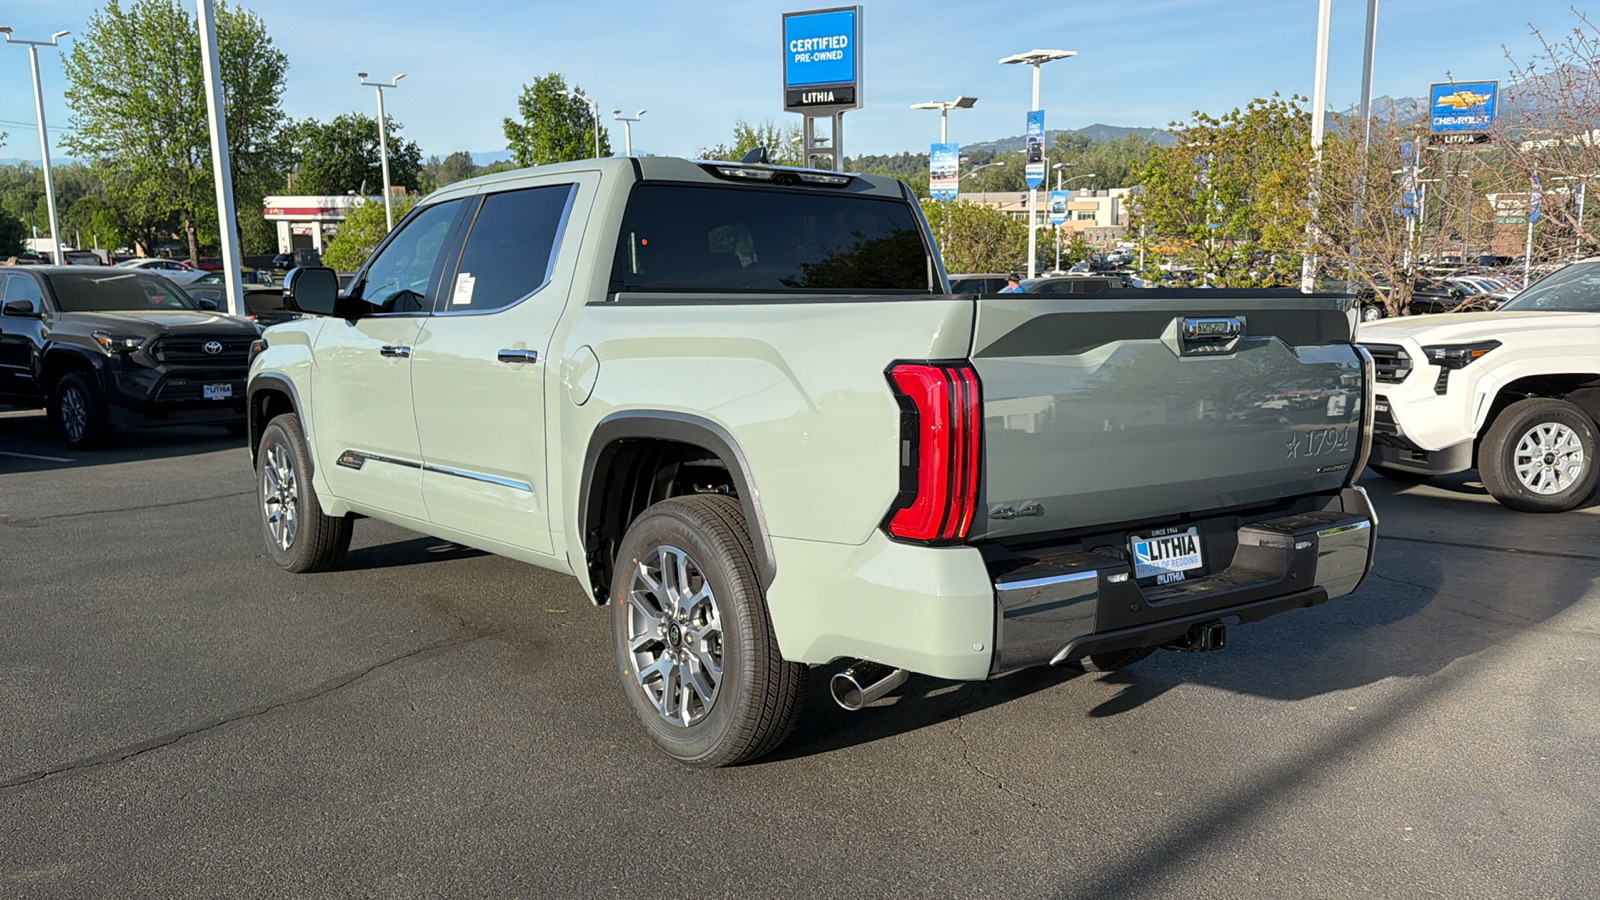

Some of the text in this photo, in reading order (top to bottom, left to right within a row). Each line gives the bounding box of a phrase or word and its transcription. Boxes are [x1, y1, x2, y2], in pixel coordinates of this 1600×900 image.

[790, 35, 848, 52] CERTIFIED
[795, 50, 843, 63] PRE-OWNED
[802, 91, 835, 104] LITHIA
[1303, 426, 1349, 456] 1794
[1149, 535, 1197, 561] LITHIA
[1136, 556, 1198, 574] TOYOTA OF REDDING
[1163, 571, 1185, 583] LITHIA
